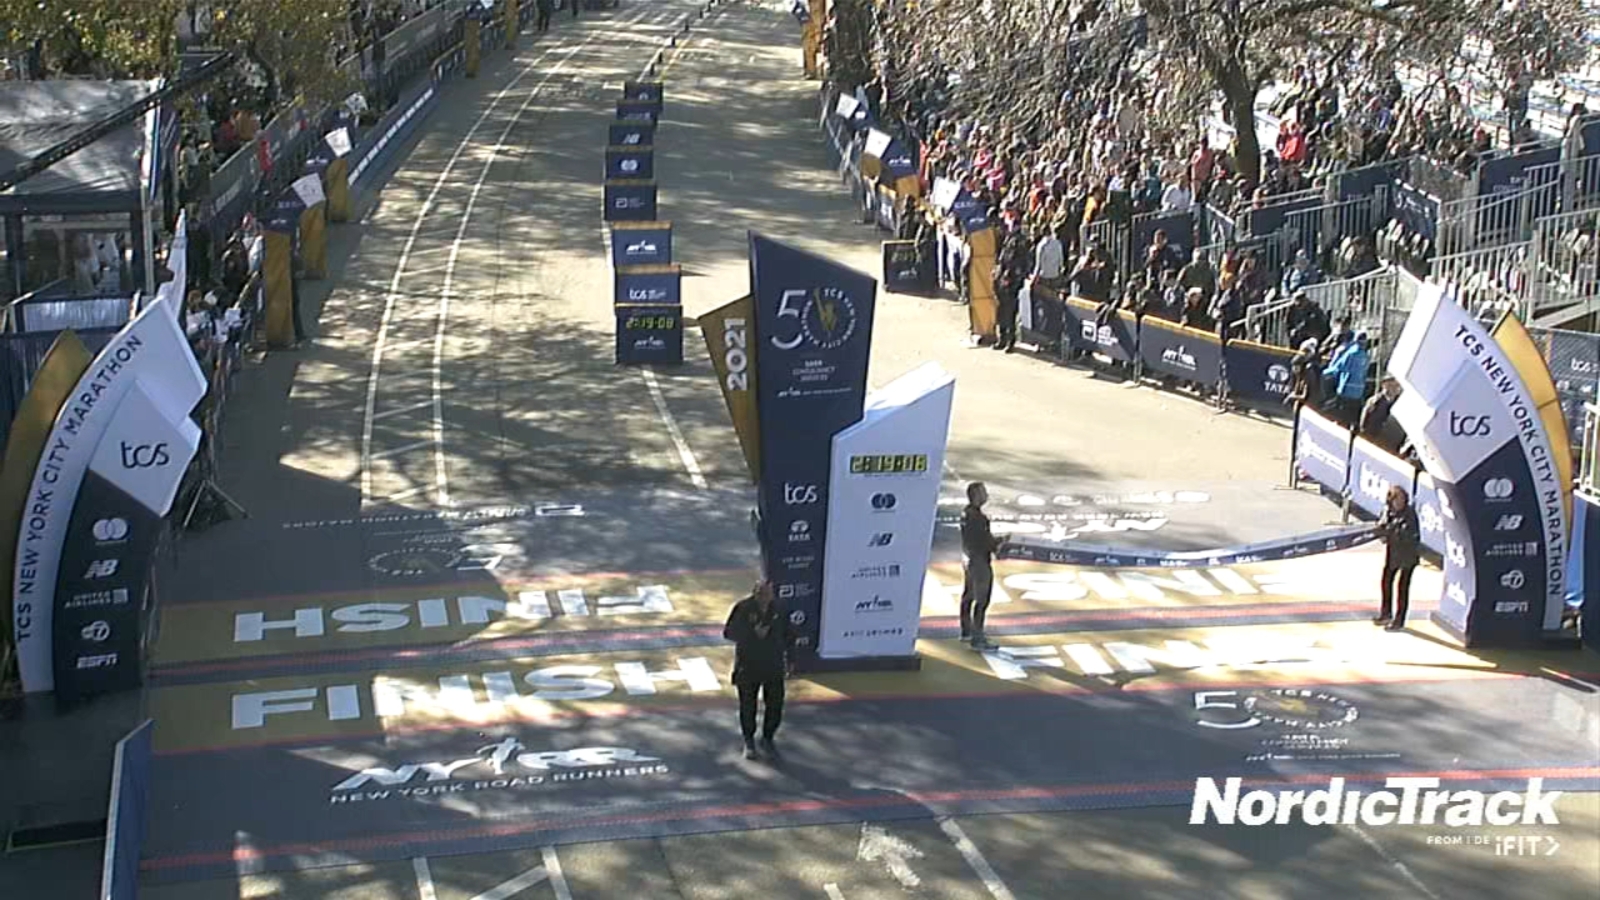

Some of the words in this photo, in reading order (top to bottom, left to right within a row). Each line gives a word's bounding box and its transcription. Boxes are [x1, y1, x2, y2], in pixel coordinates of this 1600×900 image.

[724, 318, 747, 391] 2021
[64, 335, 143, 435] MARATHON
[1451, 411, 1491, 436] tcs
[42, 438, 70, 485] CITY
[120, 441, 170, 469] tcs
[1454, 324, 1485, 356] TCS
[1481, 355, 1515, 395] NEW
[1508, 396, 1540, 442] YORK
[1531, 446, 1554, 483] CITY
[1543, 490, 1563, 596] MARATHON
[27, 488, 53, 542] YORK
[784, 482, 818, 504] tcs
[19, 549, 39, 594] NEW
[15, 603, 31, 643] TCS
[234, 585, 673, 642] FINISH
[1495, 601, 1529, 613] ESPN
[77, 653, 118, 669] ESPN
[231, 656, 721, 729] FINISH
[329, 789, 390, 804] NEW
[398, 784, 465, 797] YORK
[475, 776, 543, 790] ROAD
[553, 764, 669, 781] RUNNERS
